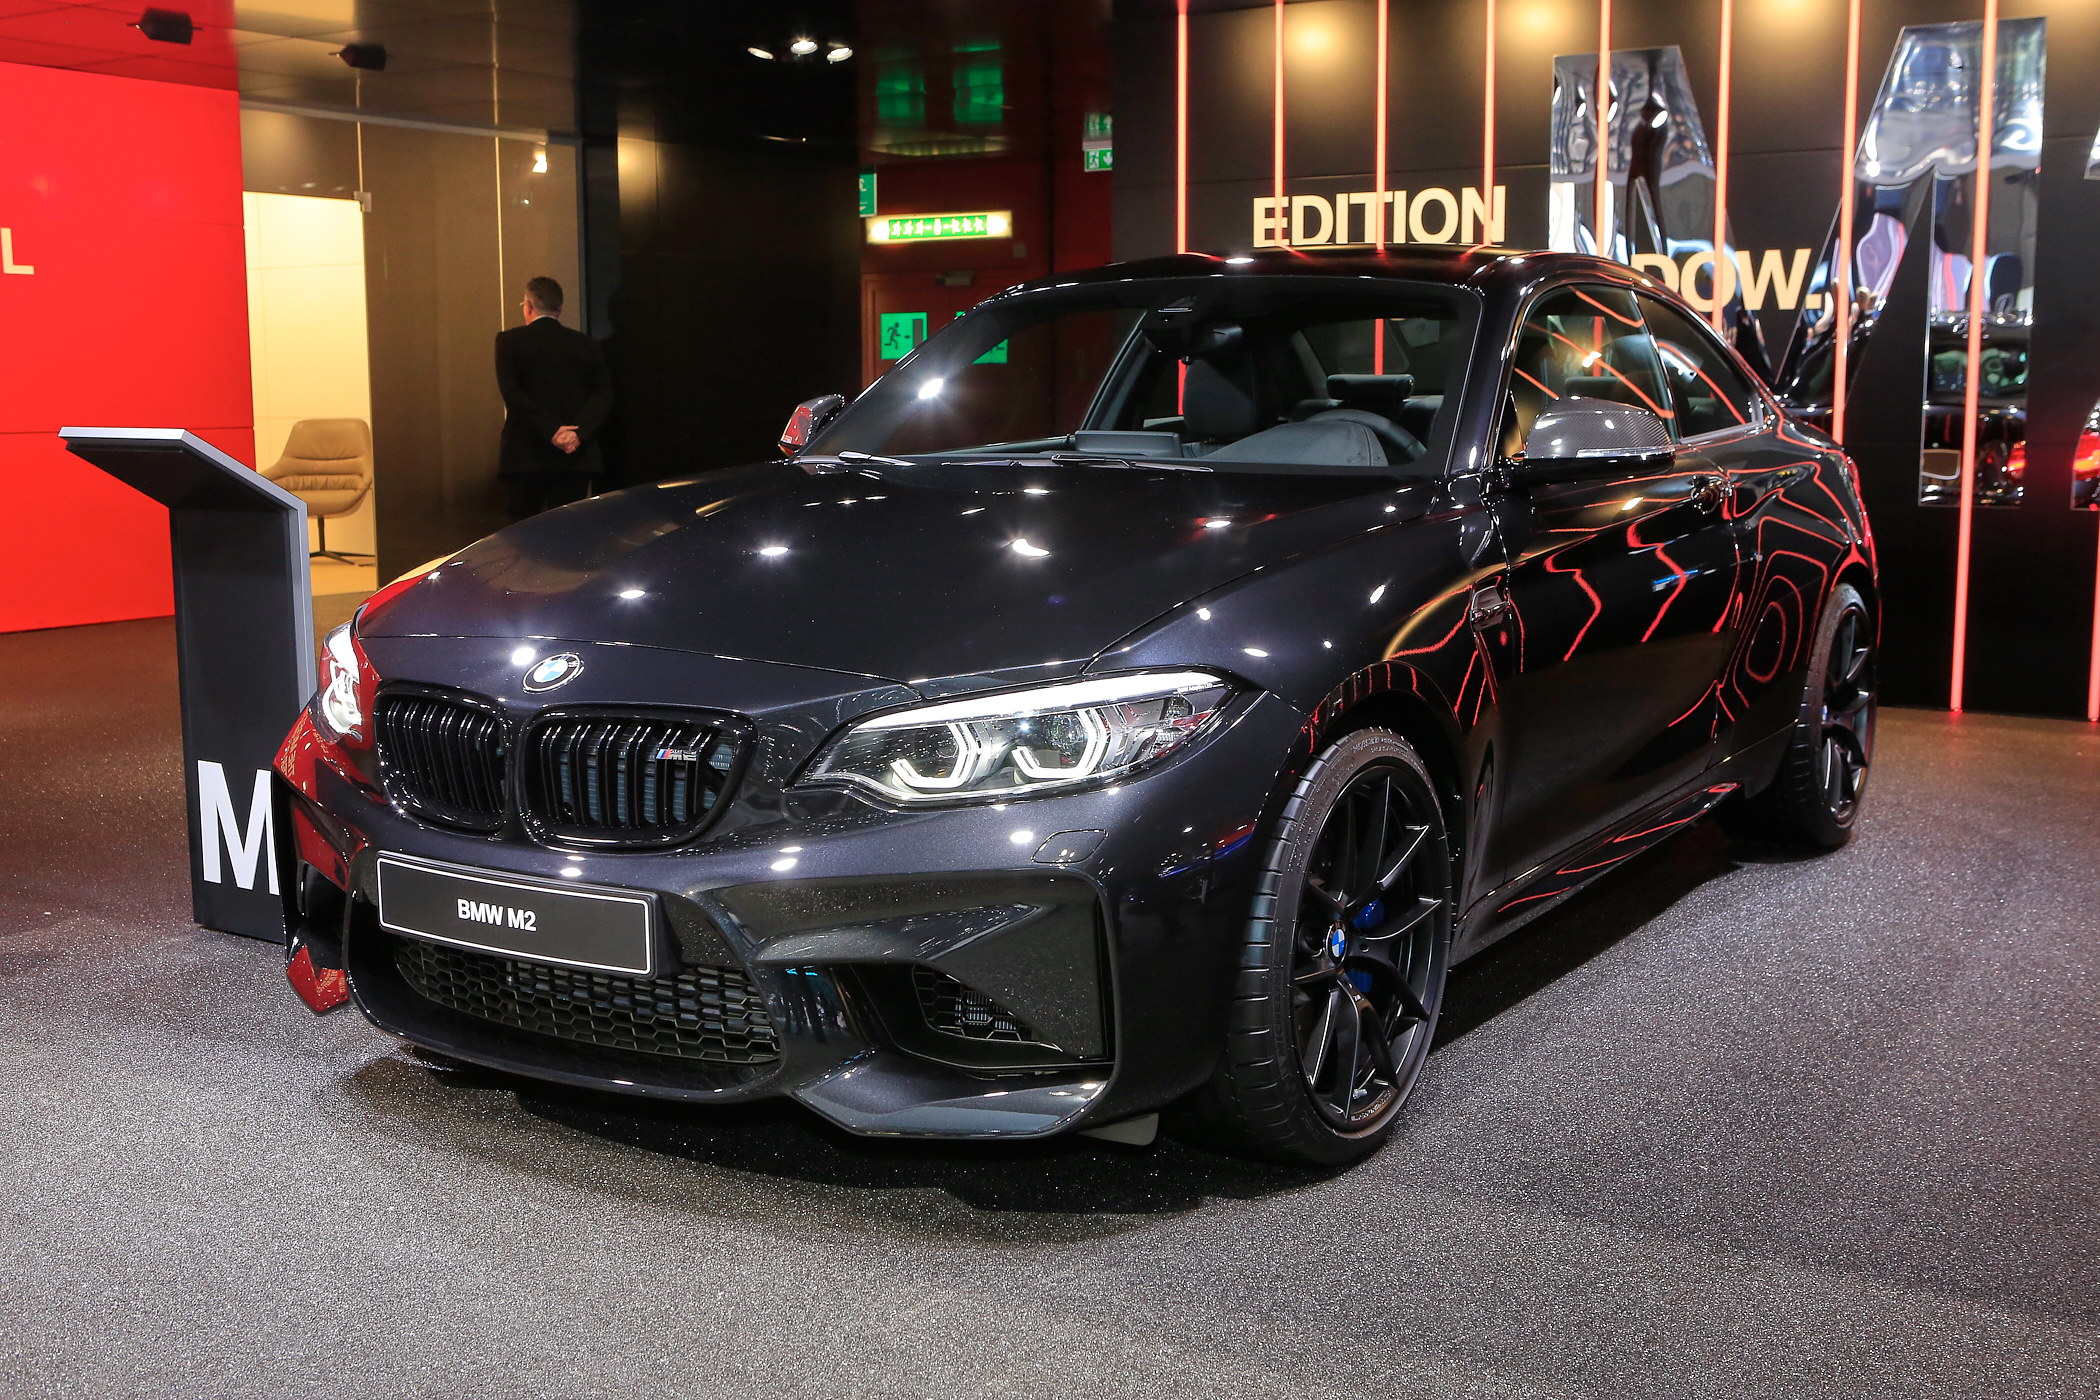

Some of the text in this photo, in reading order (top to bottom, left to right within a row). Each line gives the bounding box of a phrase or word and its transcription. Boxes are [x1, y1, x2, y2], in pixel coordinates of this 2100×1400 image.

[1252, 185, 1506, 247] EDITION
[197, 759, 281, 896] M
[457, 898, 537, 932] BMW M2
